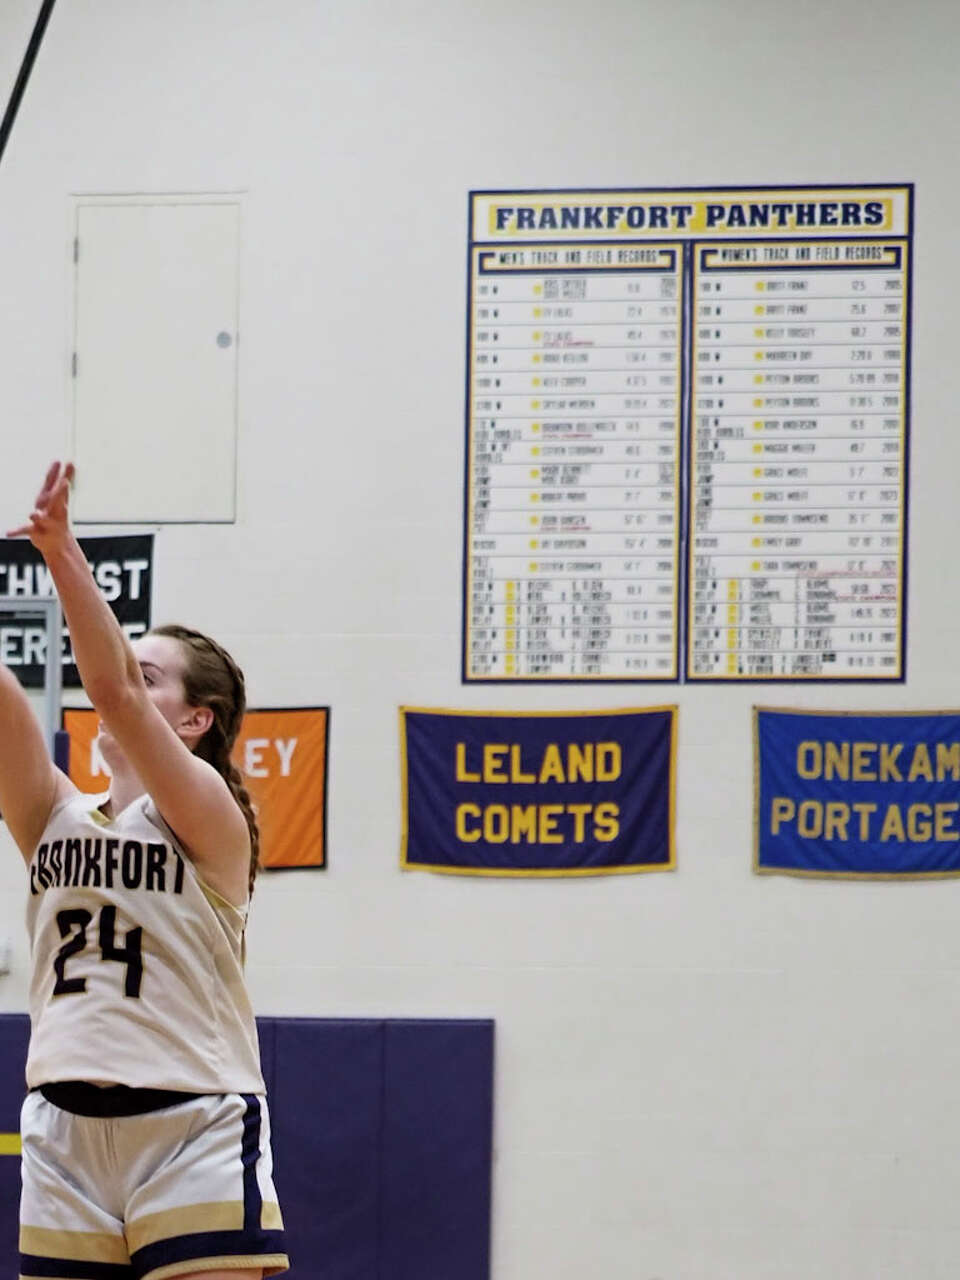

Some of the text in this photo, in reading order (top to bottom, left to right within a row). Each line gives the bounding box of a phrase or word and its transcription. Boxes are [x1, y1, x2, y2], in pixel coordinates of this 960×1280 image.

[496, 202, 884, 230] FRANKFORT PANTHERS
[531, 251, 558, 264] TRACK
[565, 251, 581, 264] AND
[587, 250, 612, 264] FIELD
[618, 249, 658, 263] RECORDS
[764, 247, 789, 261] TRACK
[795, 247, 811, 260] AND
[816, 246, 840, 260] FIELD
[845, 246, 882, 260] RECORDS
[456, 742, 622, 784] LELAND
[456, 803, 620, 845] COMETS
[771, 797, 960, 842] PORTAGE
[52, 904, 143, 999] 24
